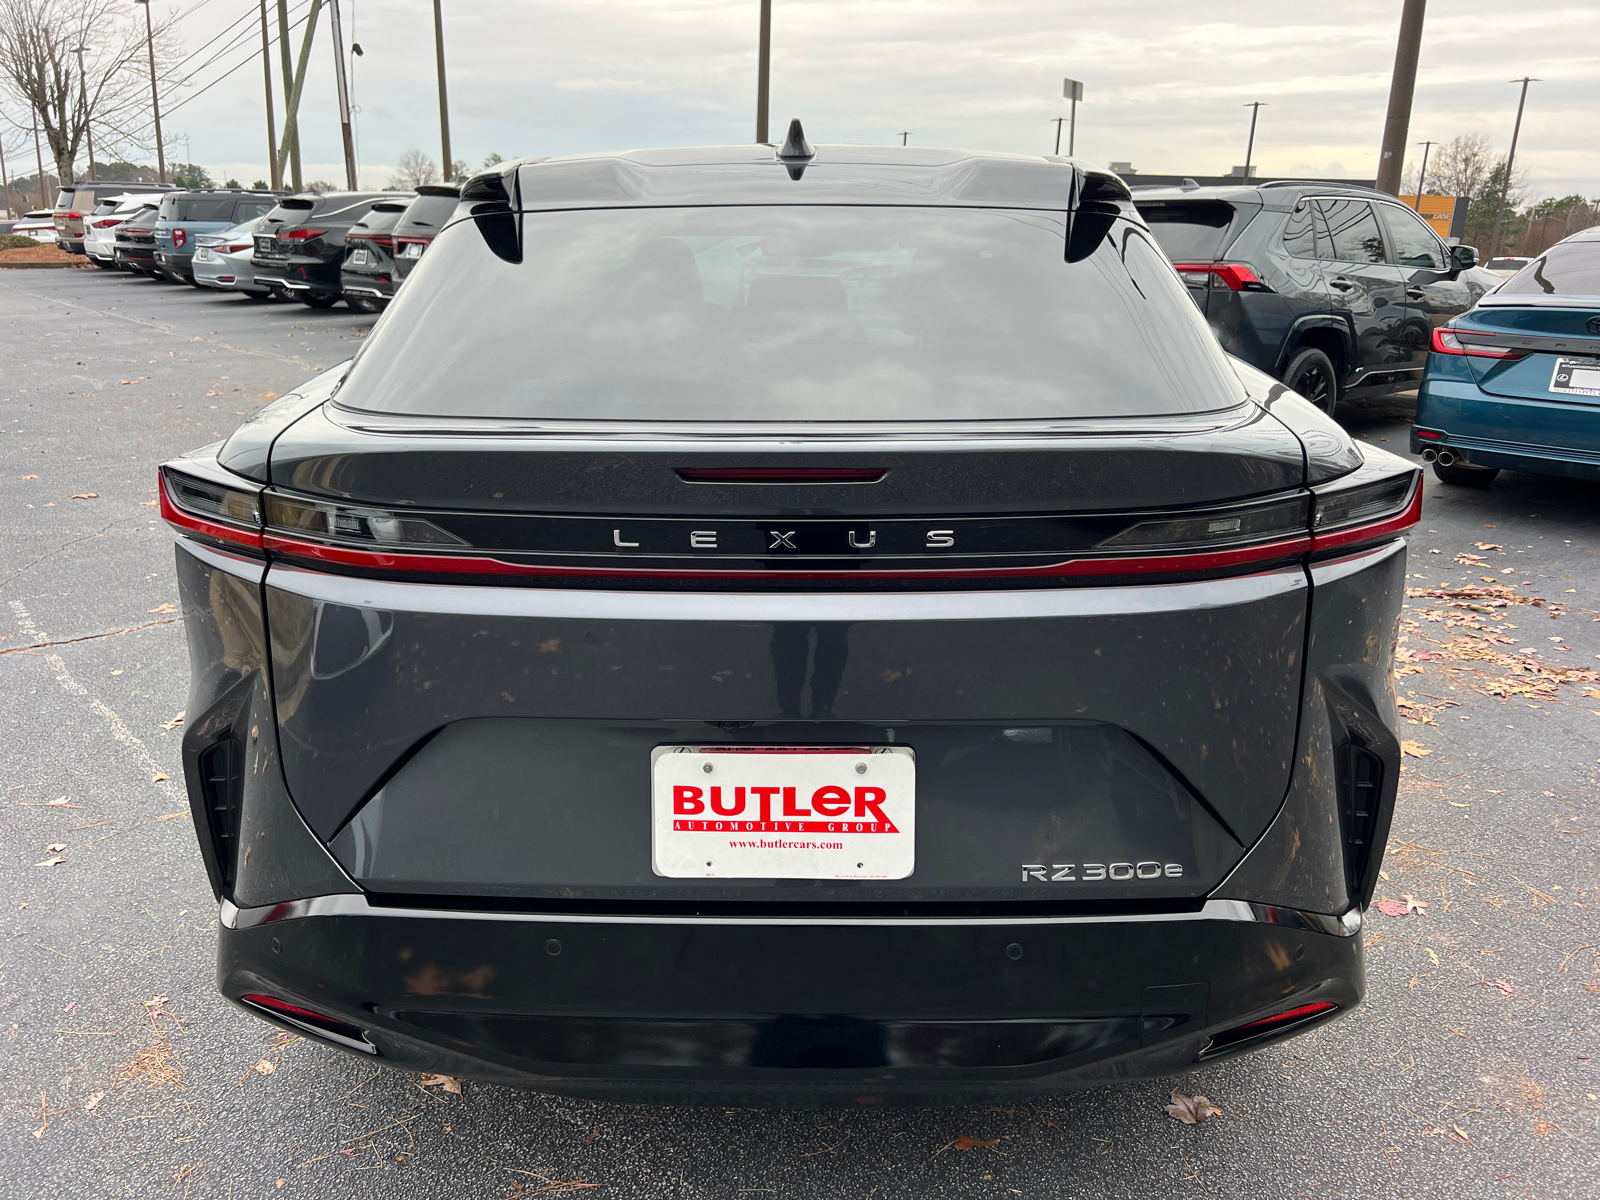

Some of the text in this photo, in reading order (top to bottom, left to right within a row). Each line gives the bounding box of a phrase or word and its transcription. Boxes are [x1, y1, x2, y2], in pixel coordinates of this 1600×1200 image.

[613, 529, 955, 549] LEXUS
[674, 820, 892, 832] AUTOMOTIVE GROUP
[729, 838, 843, 850] www.butlercars.com
[1021, 864, 1077, 882] RZ
